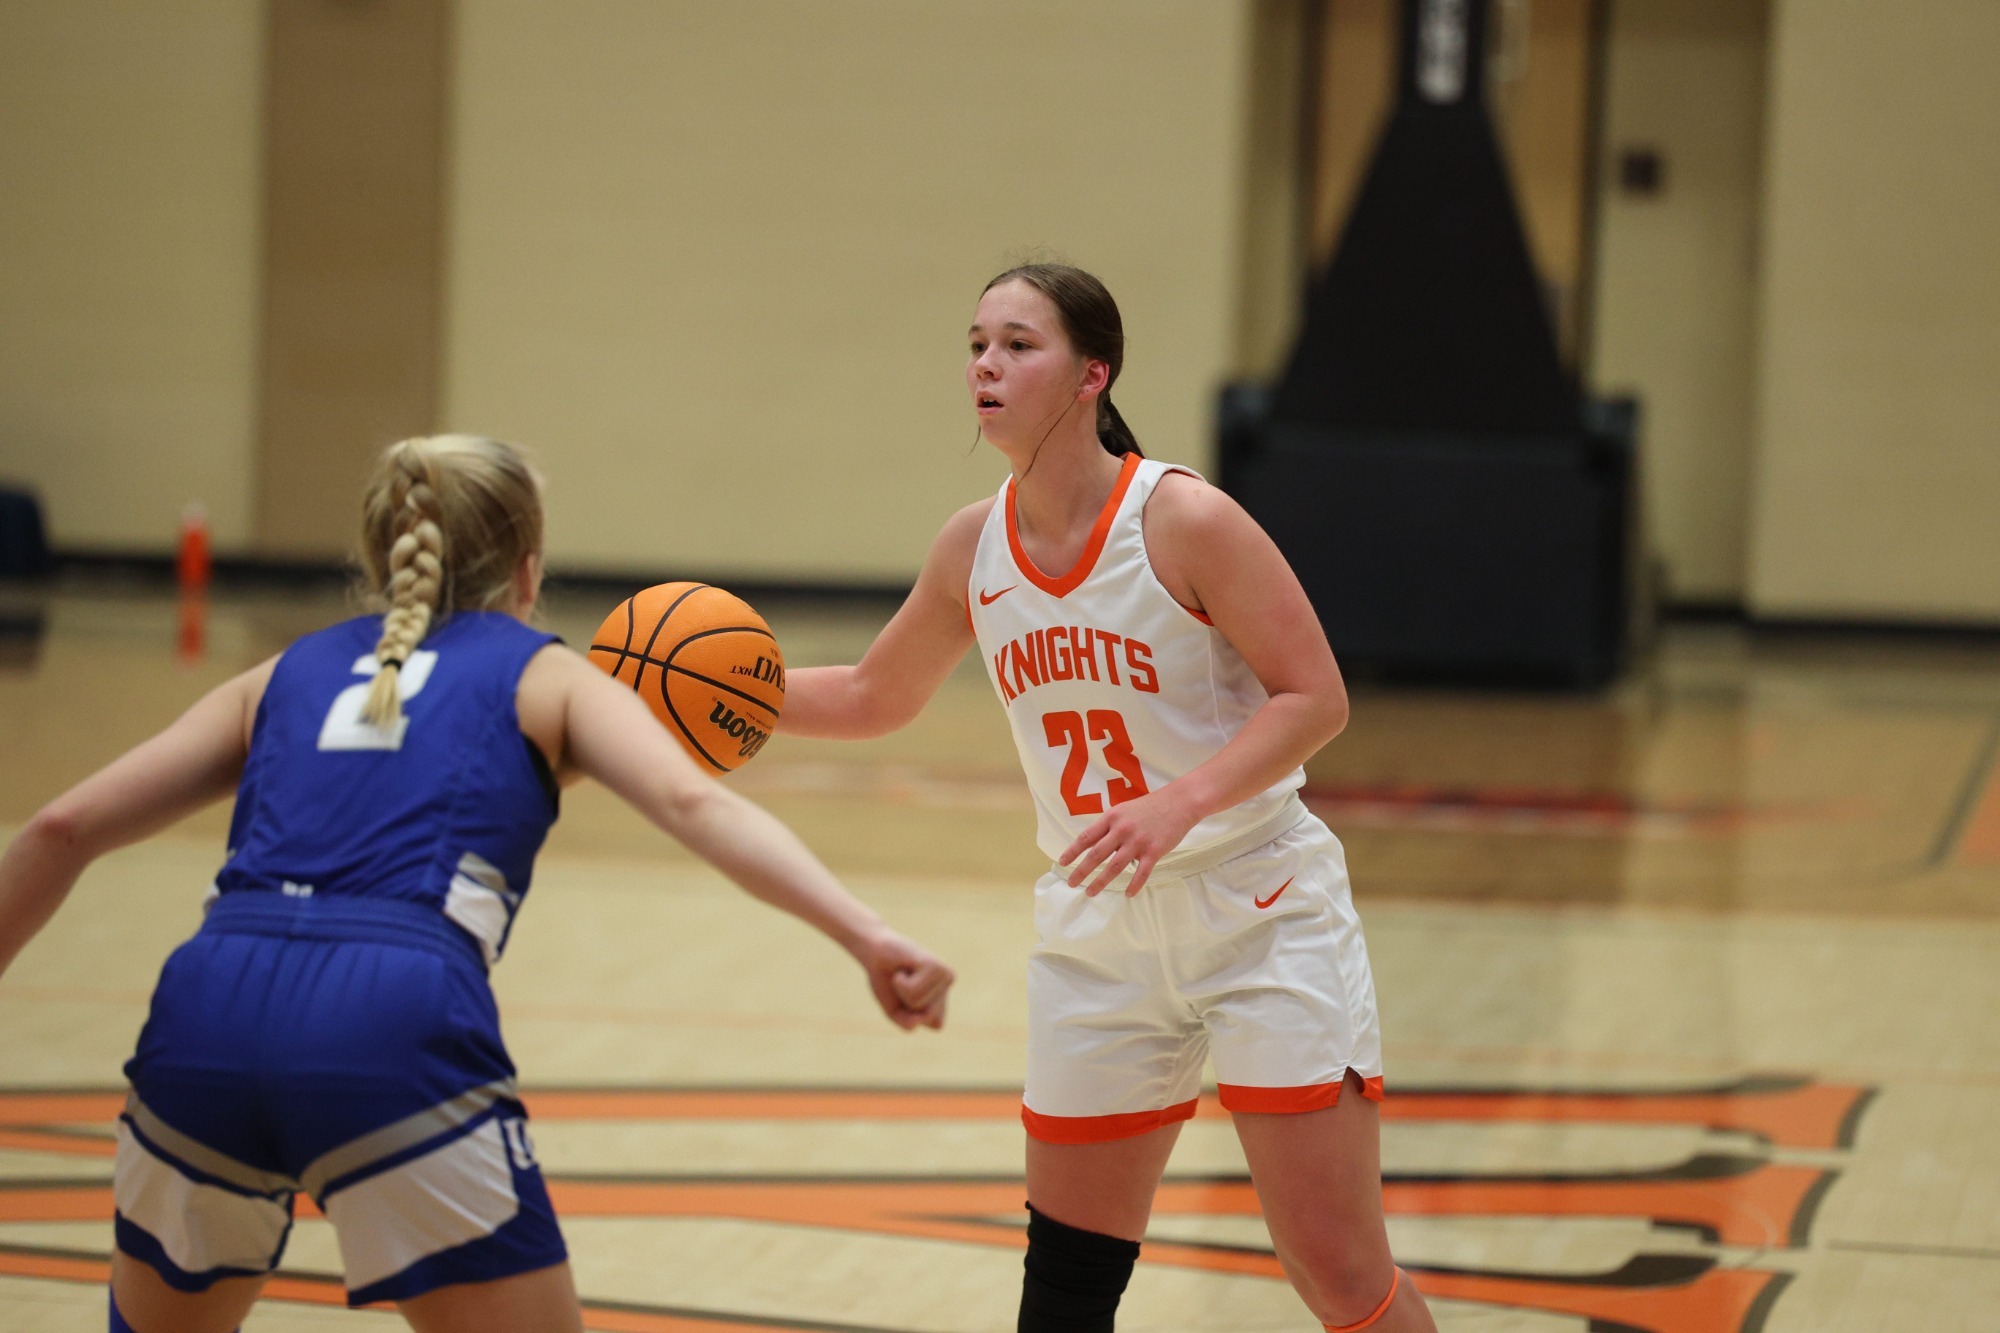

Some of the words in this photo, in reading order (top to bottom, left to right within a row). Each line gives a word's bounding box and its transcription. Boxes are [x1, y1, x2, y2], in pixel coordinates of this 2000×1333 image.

[317, 650, 439, 751] 2
[729, 665, 752, 676] NXT
[994, 626, 1160, 708] KNIGHTS
[1042, 709, 1150, 816] 23
